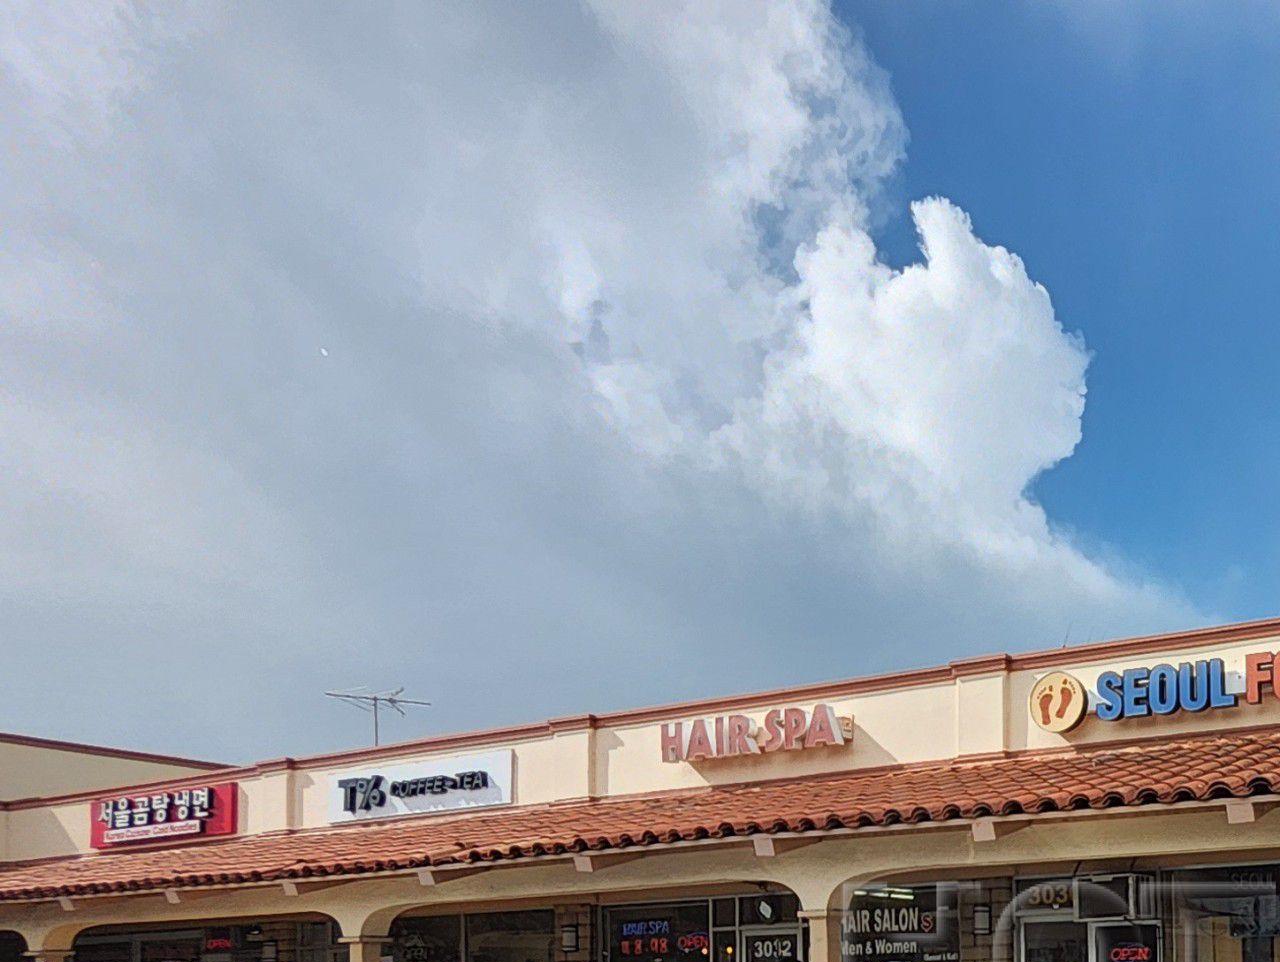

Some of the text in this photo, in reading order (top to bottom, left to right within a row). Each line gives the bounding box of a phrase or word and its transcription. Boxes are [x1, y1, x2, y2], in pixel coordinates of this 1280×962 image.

[1096, 658, 1237, 721] SEOUL
[660, 703, 844, 763] HAIR SPA
[1027, 884, 1073, 905] 303
[648, 920, 670, 935] SPA
[873, 906, 919, 933] SALON
[206, 937, 233, 950] OPEN
[678, 935, 709, 951] OPEN
[865, 940, 874, 955] &
[874, 938, 918, 955] Women
[1110, 946, 1151, 962] OPEN
